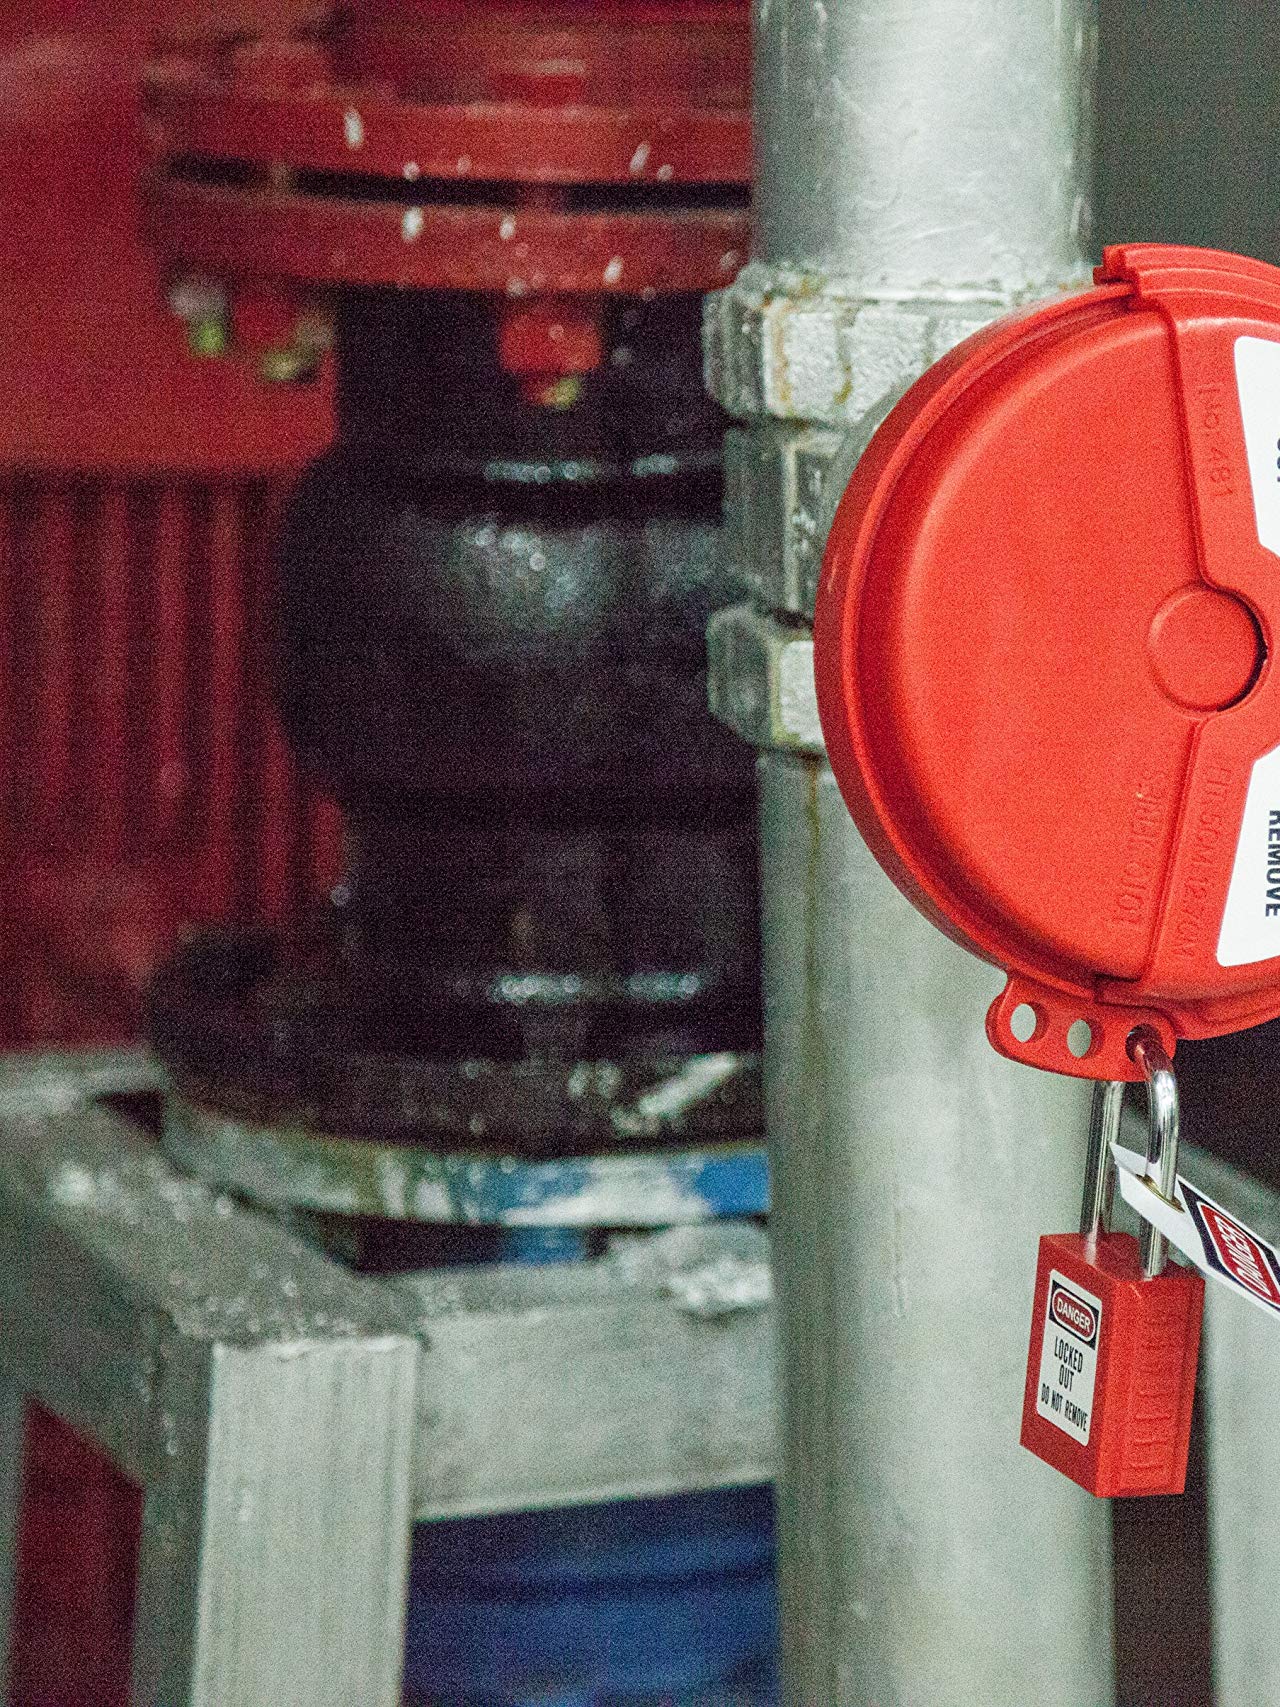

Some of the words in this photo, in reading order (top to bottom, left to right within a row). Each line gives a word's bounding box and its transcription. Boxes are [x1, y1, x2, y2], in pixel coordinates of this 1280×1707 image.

[1056, 1299, 1091, 1333] DANGER
[1054, 1336, 1084, 1373] LOCKED
[1058, 1364, 1075, 1392] OUT
[1041, 1383, 1050, 1405] DO
[1051, 1390, 1063, 1412] NOT
[1064, 1399, 1089, 1432] REMOVE
